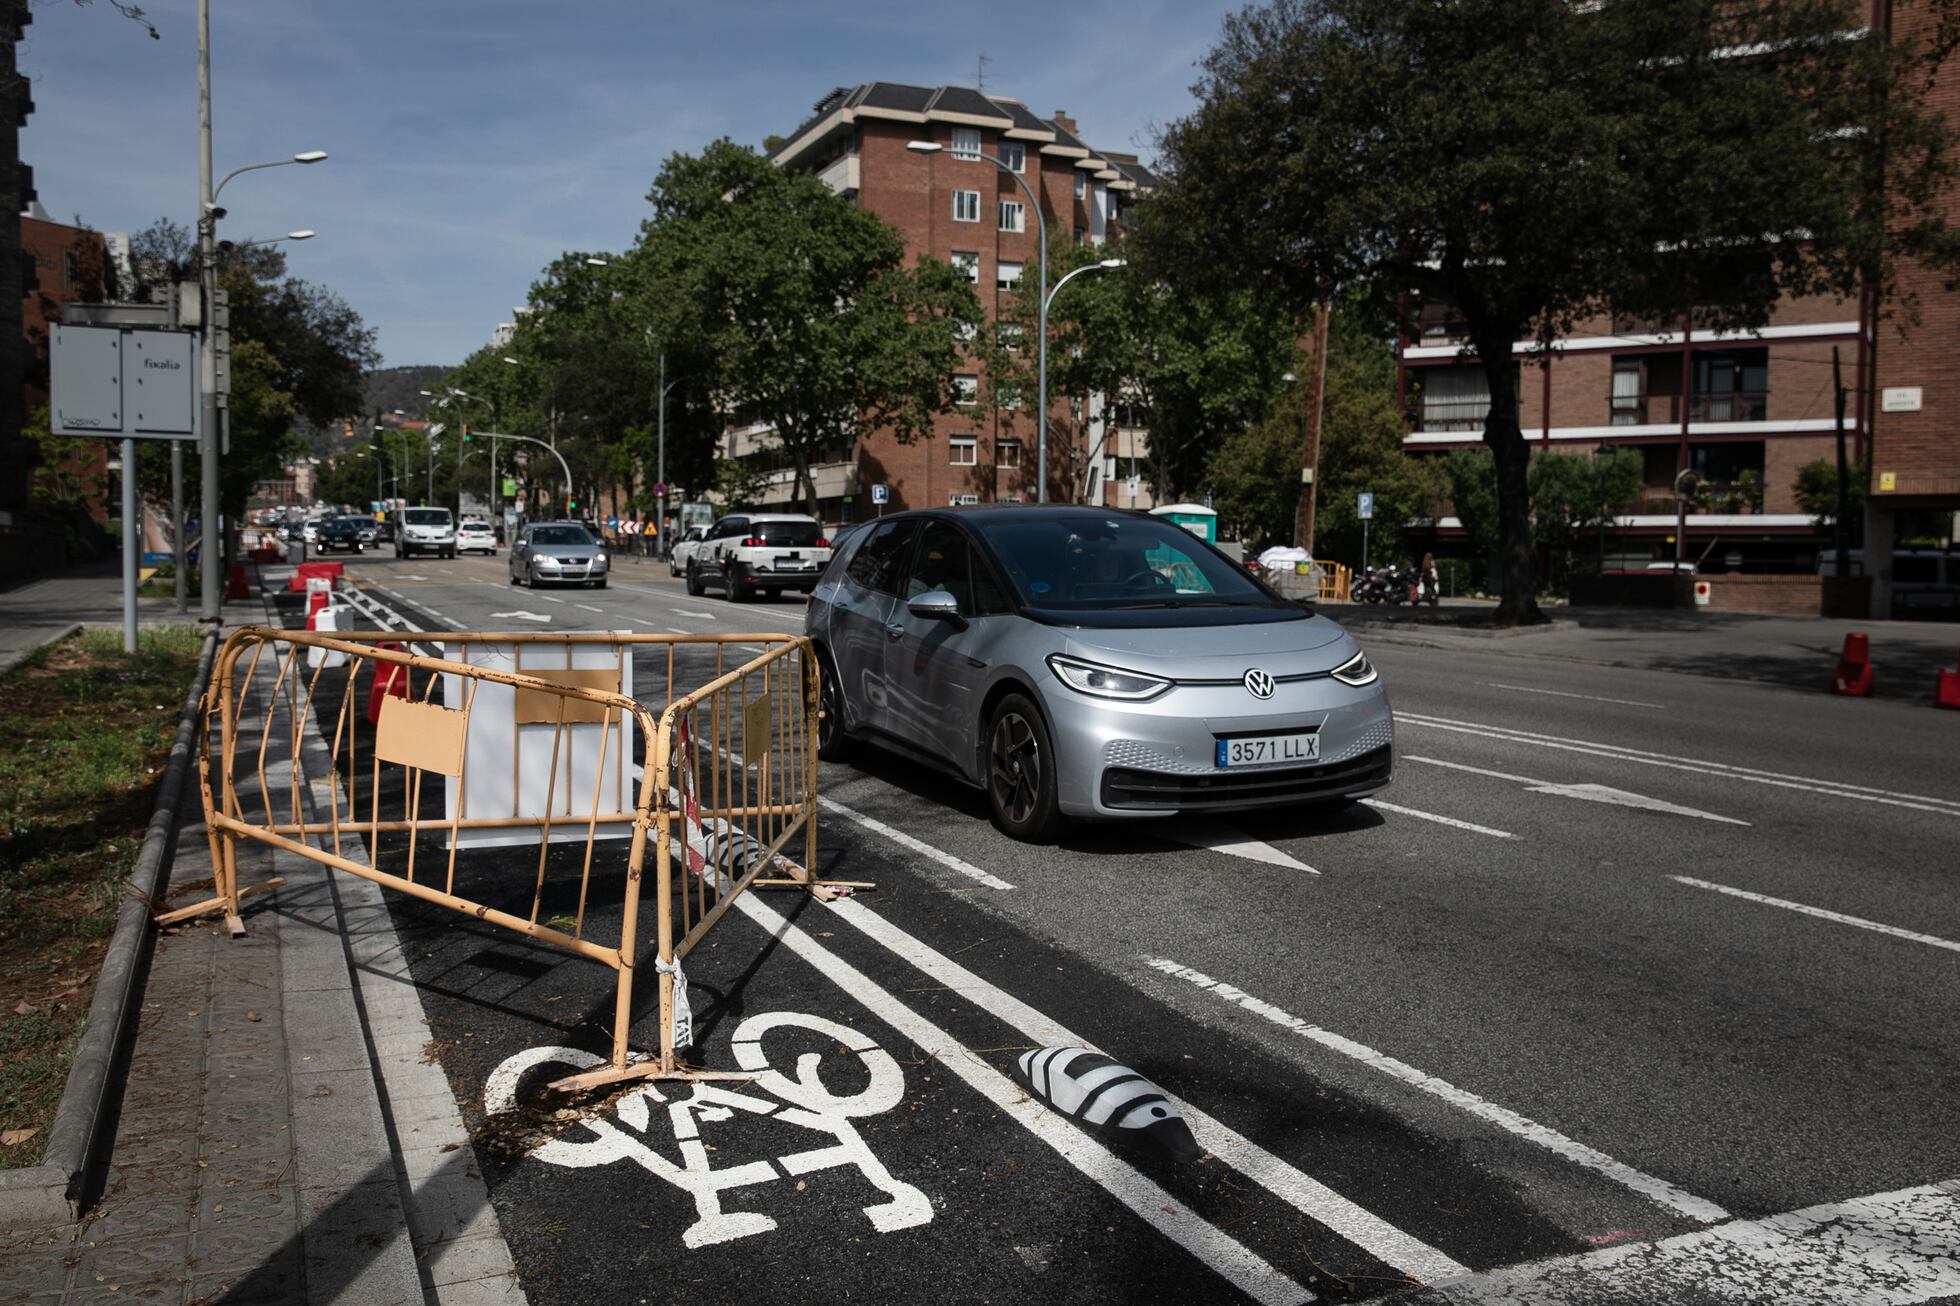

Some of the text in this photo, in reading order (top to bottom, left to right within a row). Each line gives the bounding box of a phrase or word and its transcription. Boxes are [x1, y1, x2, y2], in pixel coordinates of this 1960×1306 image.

[876, 488, 885, 499] P
[1361, 497, 1369, 510] P
[1232, 738, 1316, 762] 3571 LLX
